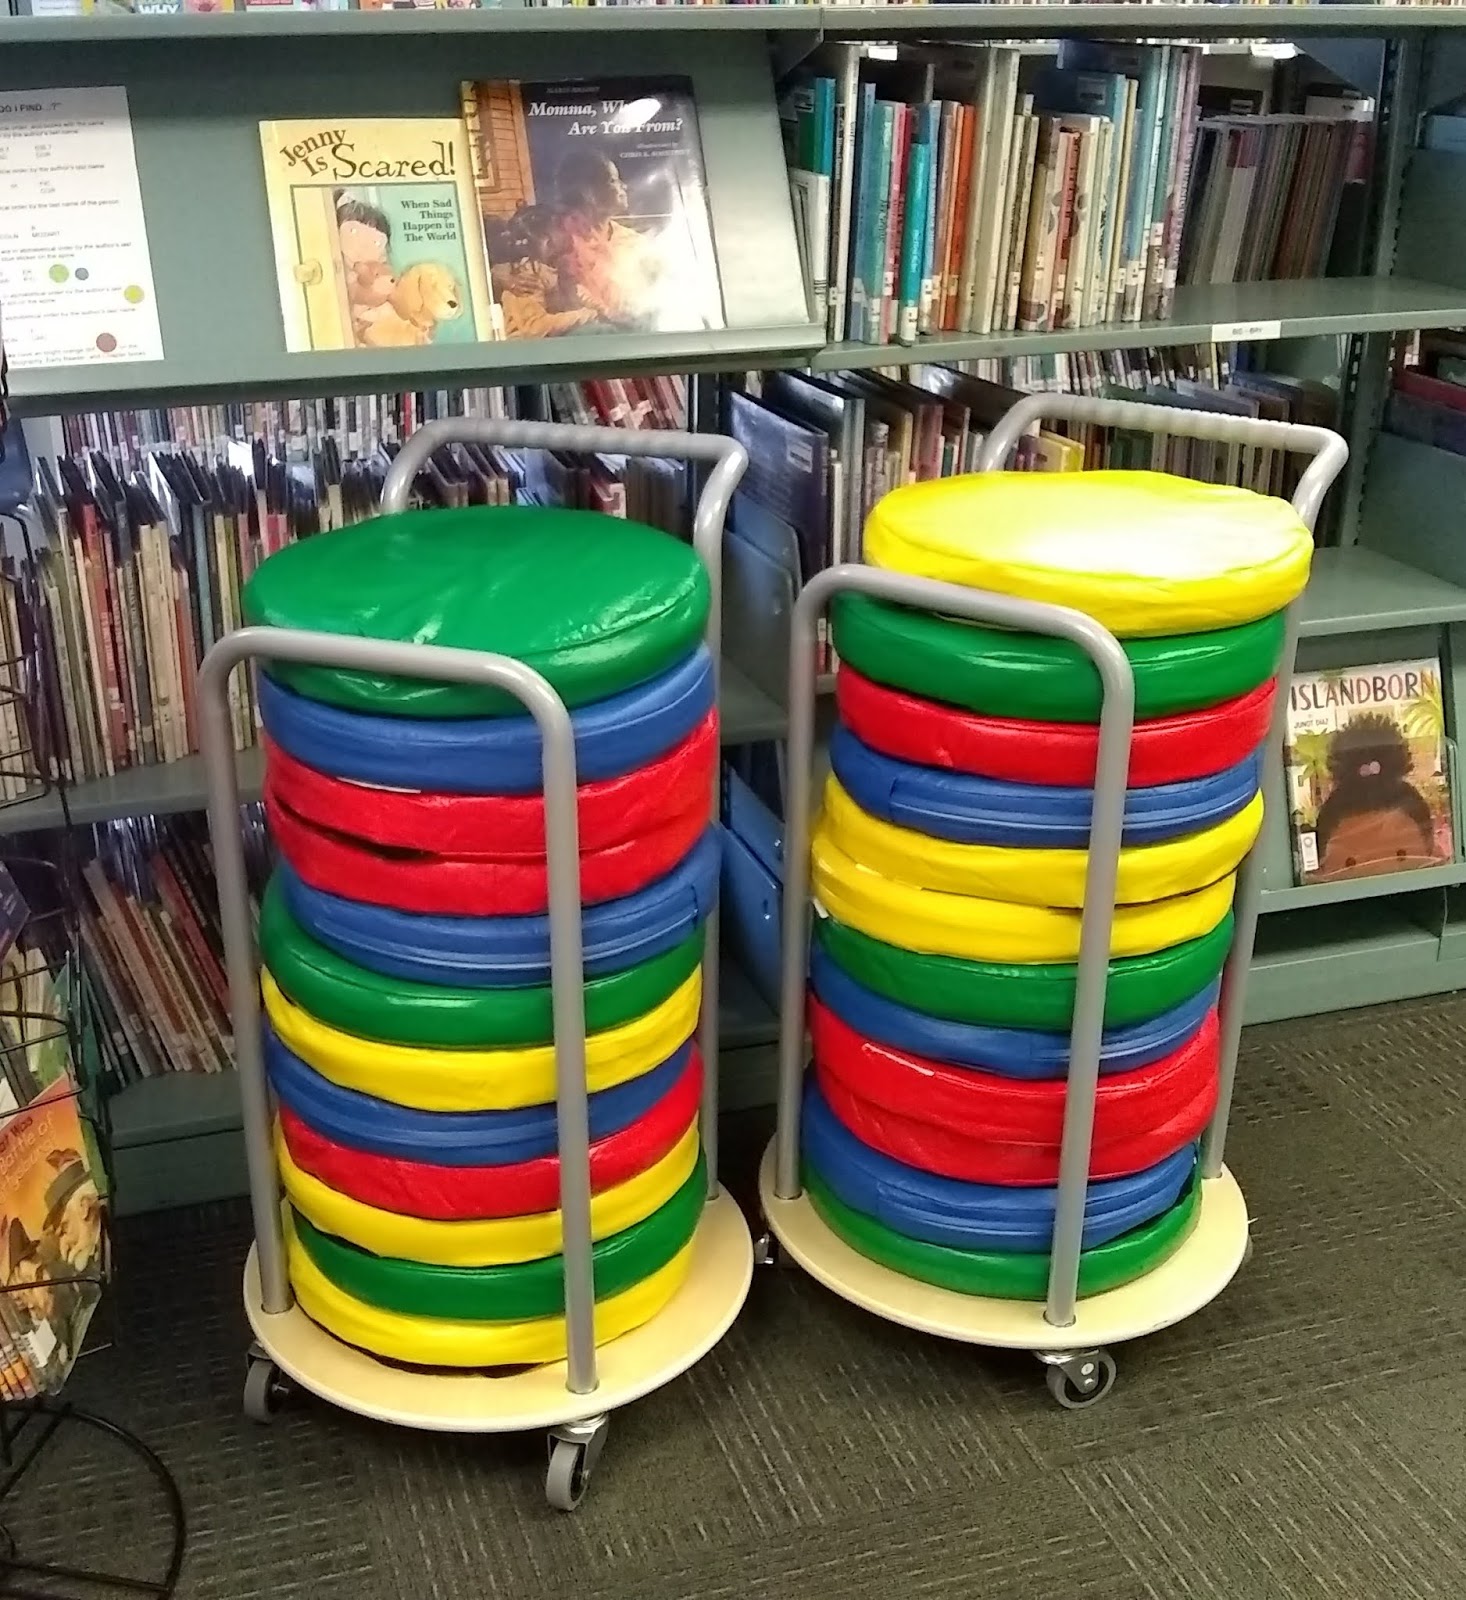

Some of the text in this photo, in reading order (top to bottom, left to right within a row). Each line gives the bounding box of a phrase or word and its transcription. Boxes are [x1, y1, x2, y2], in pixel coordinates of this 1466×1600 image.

[20, 103, 42, 112] FIND
[528, 102, 597, 117] Momma,
[568, 121, 597, 136] Are
[279, 129, 346, 167] Jenny
[301, 140, 456, 180] Is Scared!
[401, 198, 452, 209] When Sad
[419, 210, 454, 220] Things
[403, 221, 456, 233] Happen in
[404, 231, 457, 242] The World
[1291, 669, 1434, 712] ISLANDBORN
